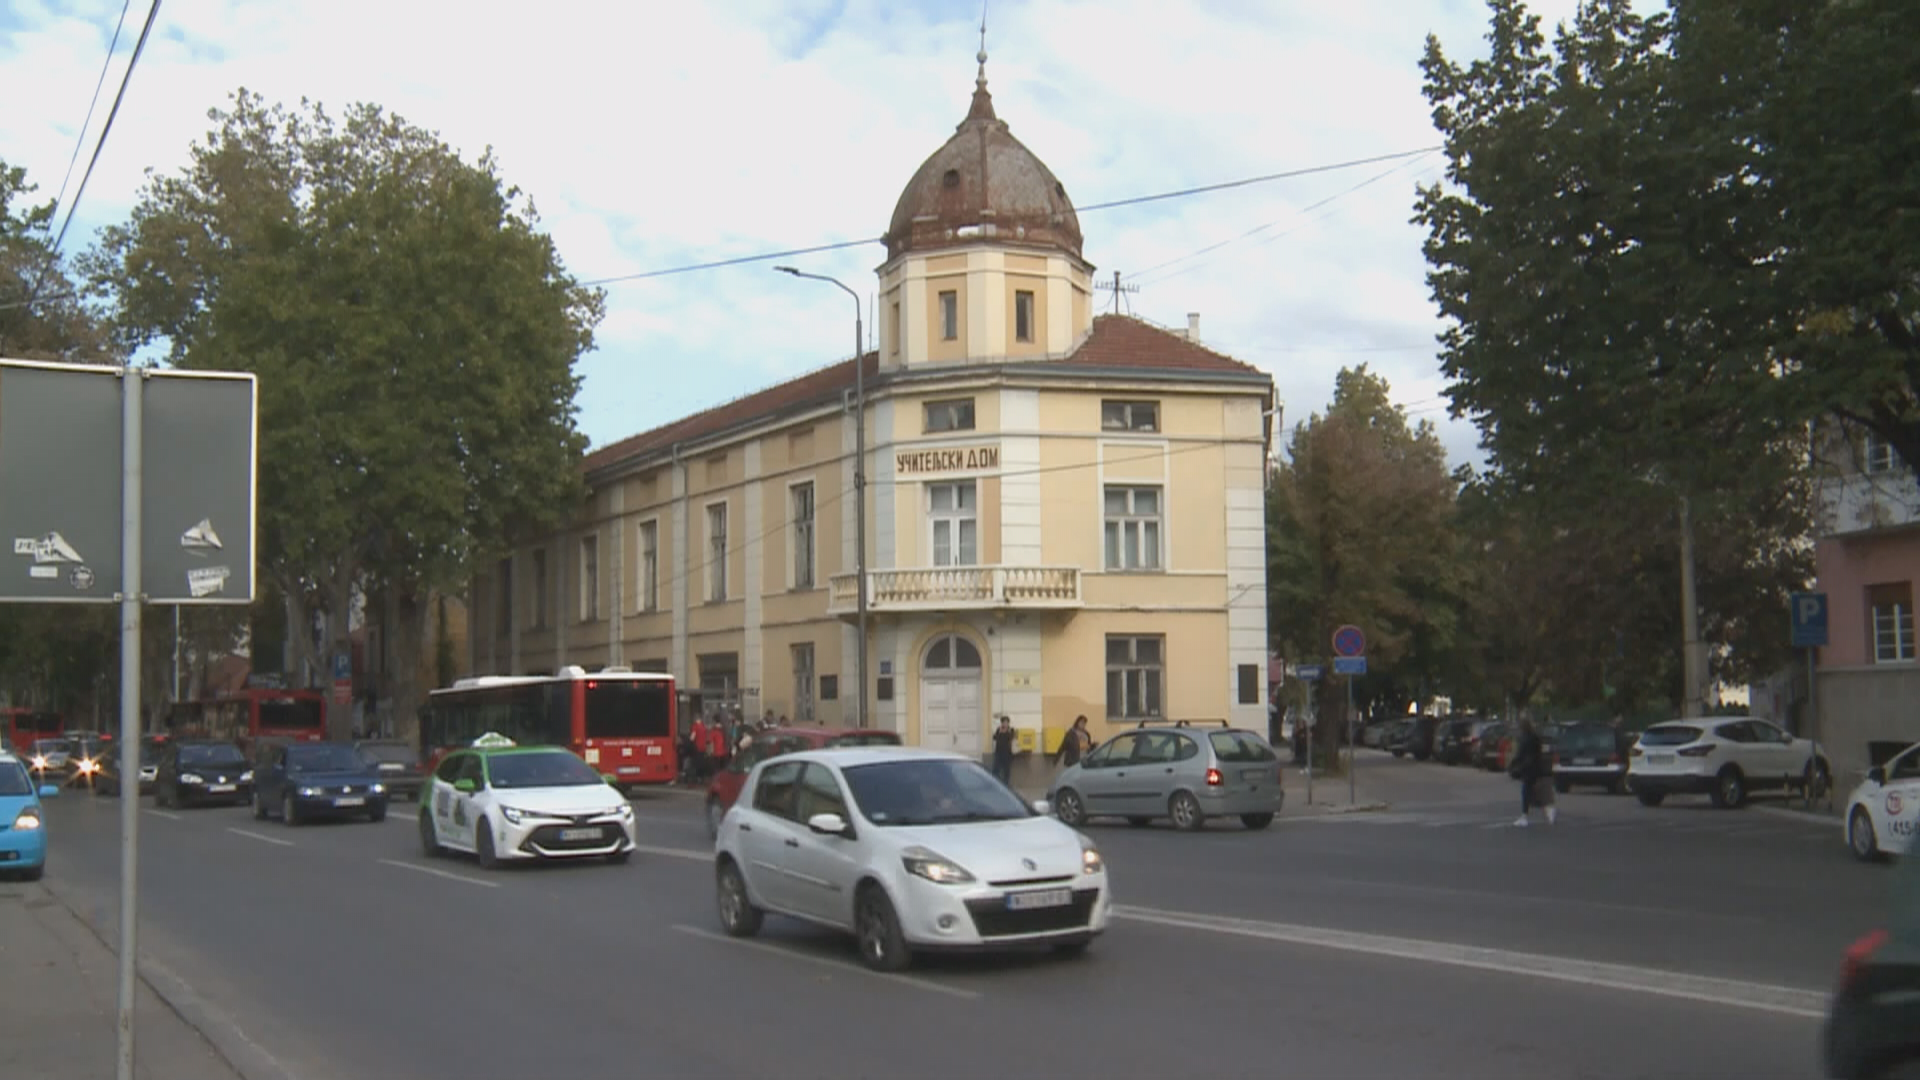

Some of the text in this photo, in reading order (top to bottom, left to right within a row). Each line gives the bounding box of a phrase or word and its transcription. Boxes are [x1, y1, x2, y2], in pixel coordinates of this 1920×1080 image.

[897, 447, 998, 473] УЧИТЕЉСКИ ДОМ
[1799, 598, 1819, 624] P
